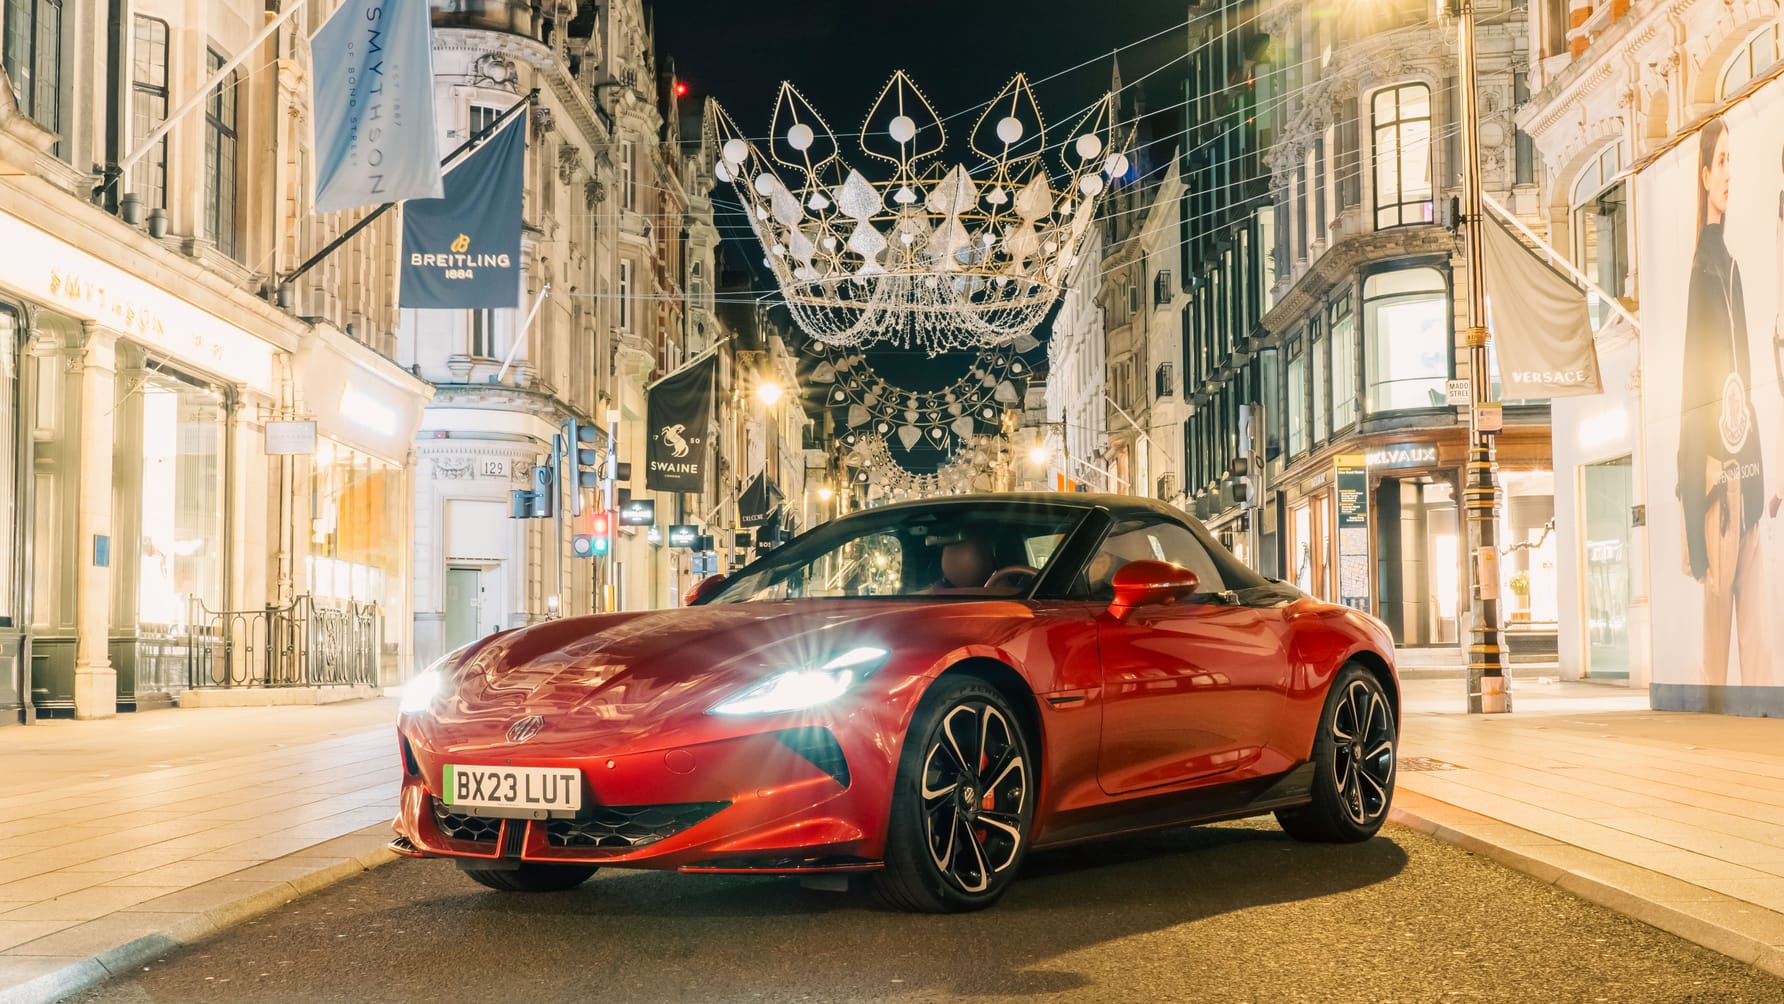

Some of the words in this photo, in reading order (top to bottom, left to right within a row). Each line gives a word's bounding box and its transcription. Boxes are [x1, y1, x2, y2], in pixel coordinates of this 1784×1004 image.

[347, 41, 355, 57] OF
[347, 67, 357, 108] BOND
[366, 7, 385, 195] SMYTHSON
[411, 253, 511, 268] BREITLING
[445, 269, 474, 280] 1884
[1512, 371, 1585, 384] VERSACE
[485, 462, 503, 474] 129
[650, 461, 698, 474] SWAINE
[1741, 463, 1760, 479] SOON
[457, 771, 518, 802] BX23
[525, 773, 576, 805] LUT
